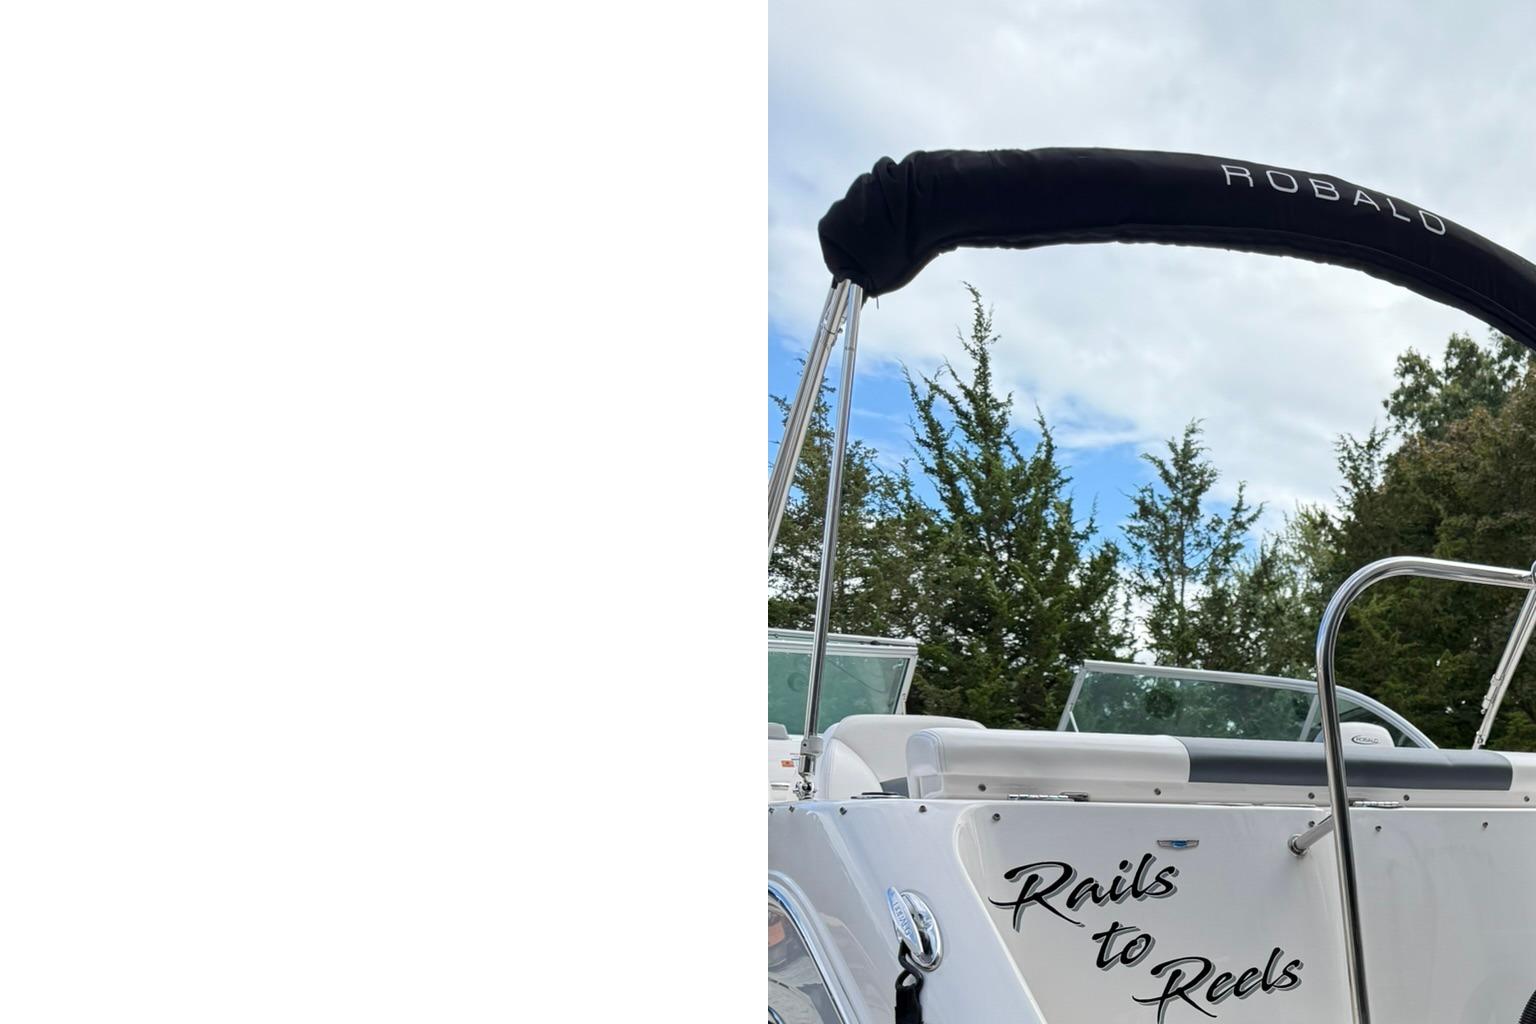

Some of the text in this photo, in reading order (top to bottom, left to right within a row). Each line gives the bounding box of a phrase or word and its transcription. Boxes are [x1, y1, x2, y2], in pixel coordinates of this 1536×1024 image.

[1221, 164, 1446, 236] ROBALO
[988, 853, 1180, 934] Rails
[1091, 921, 1156, 972] to
